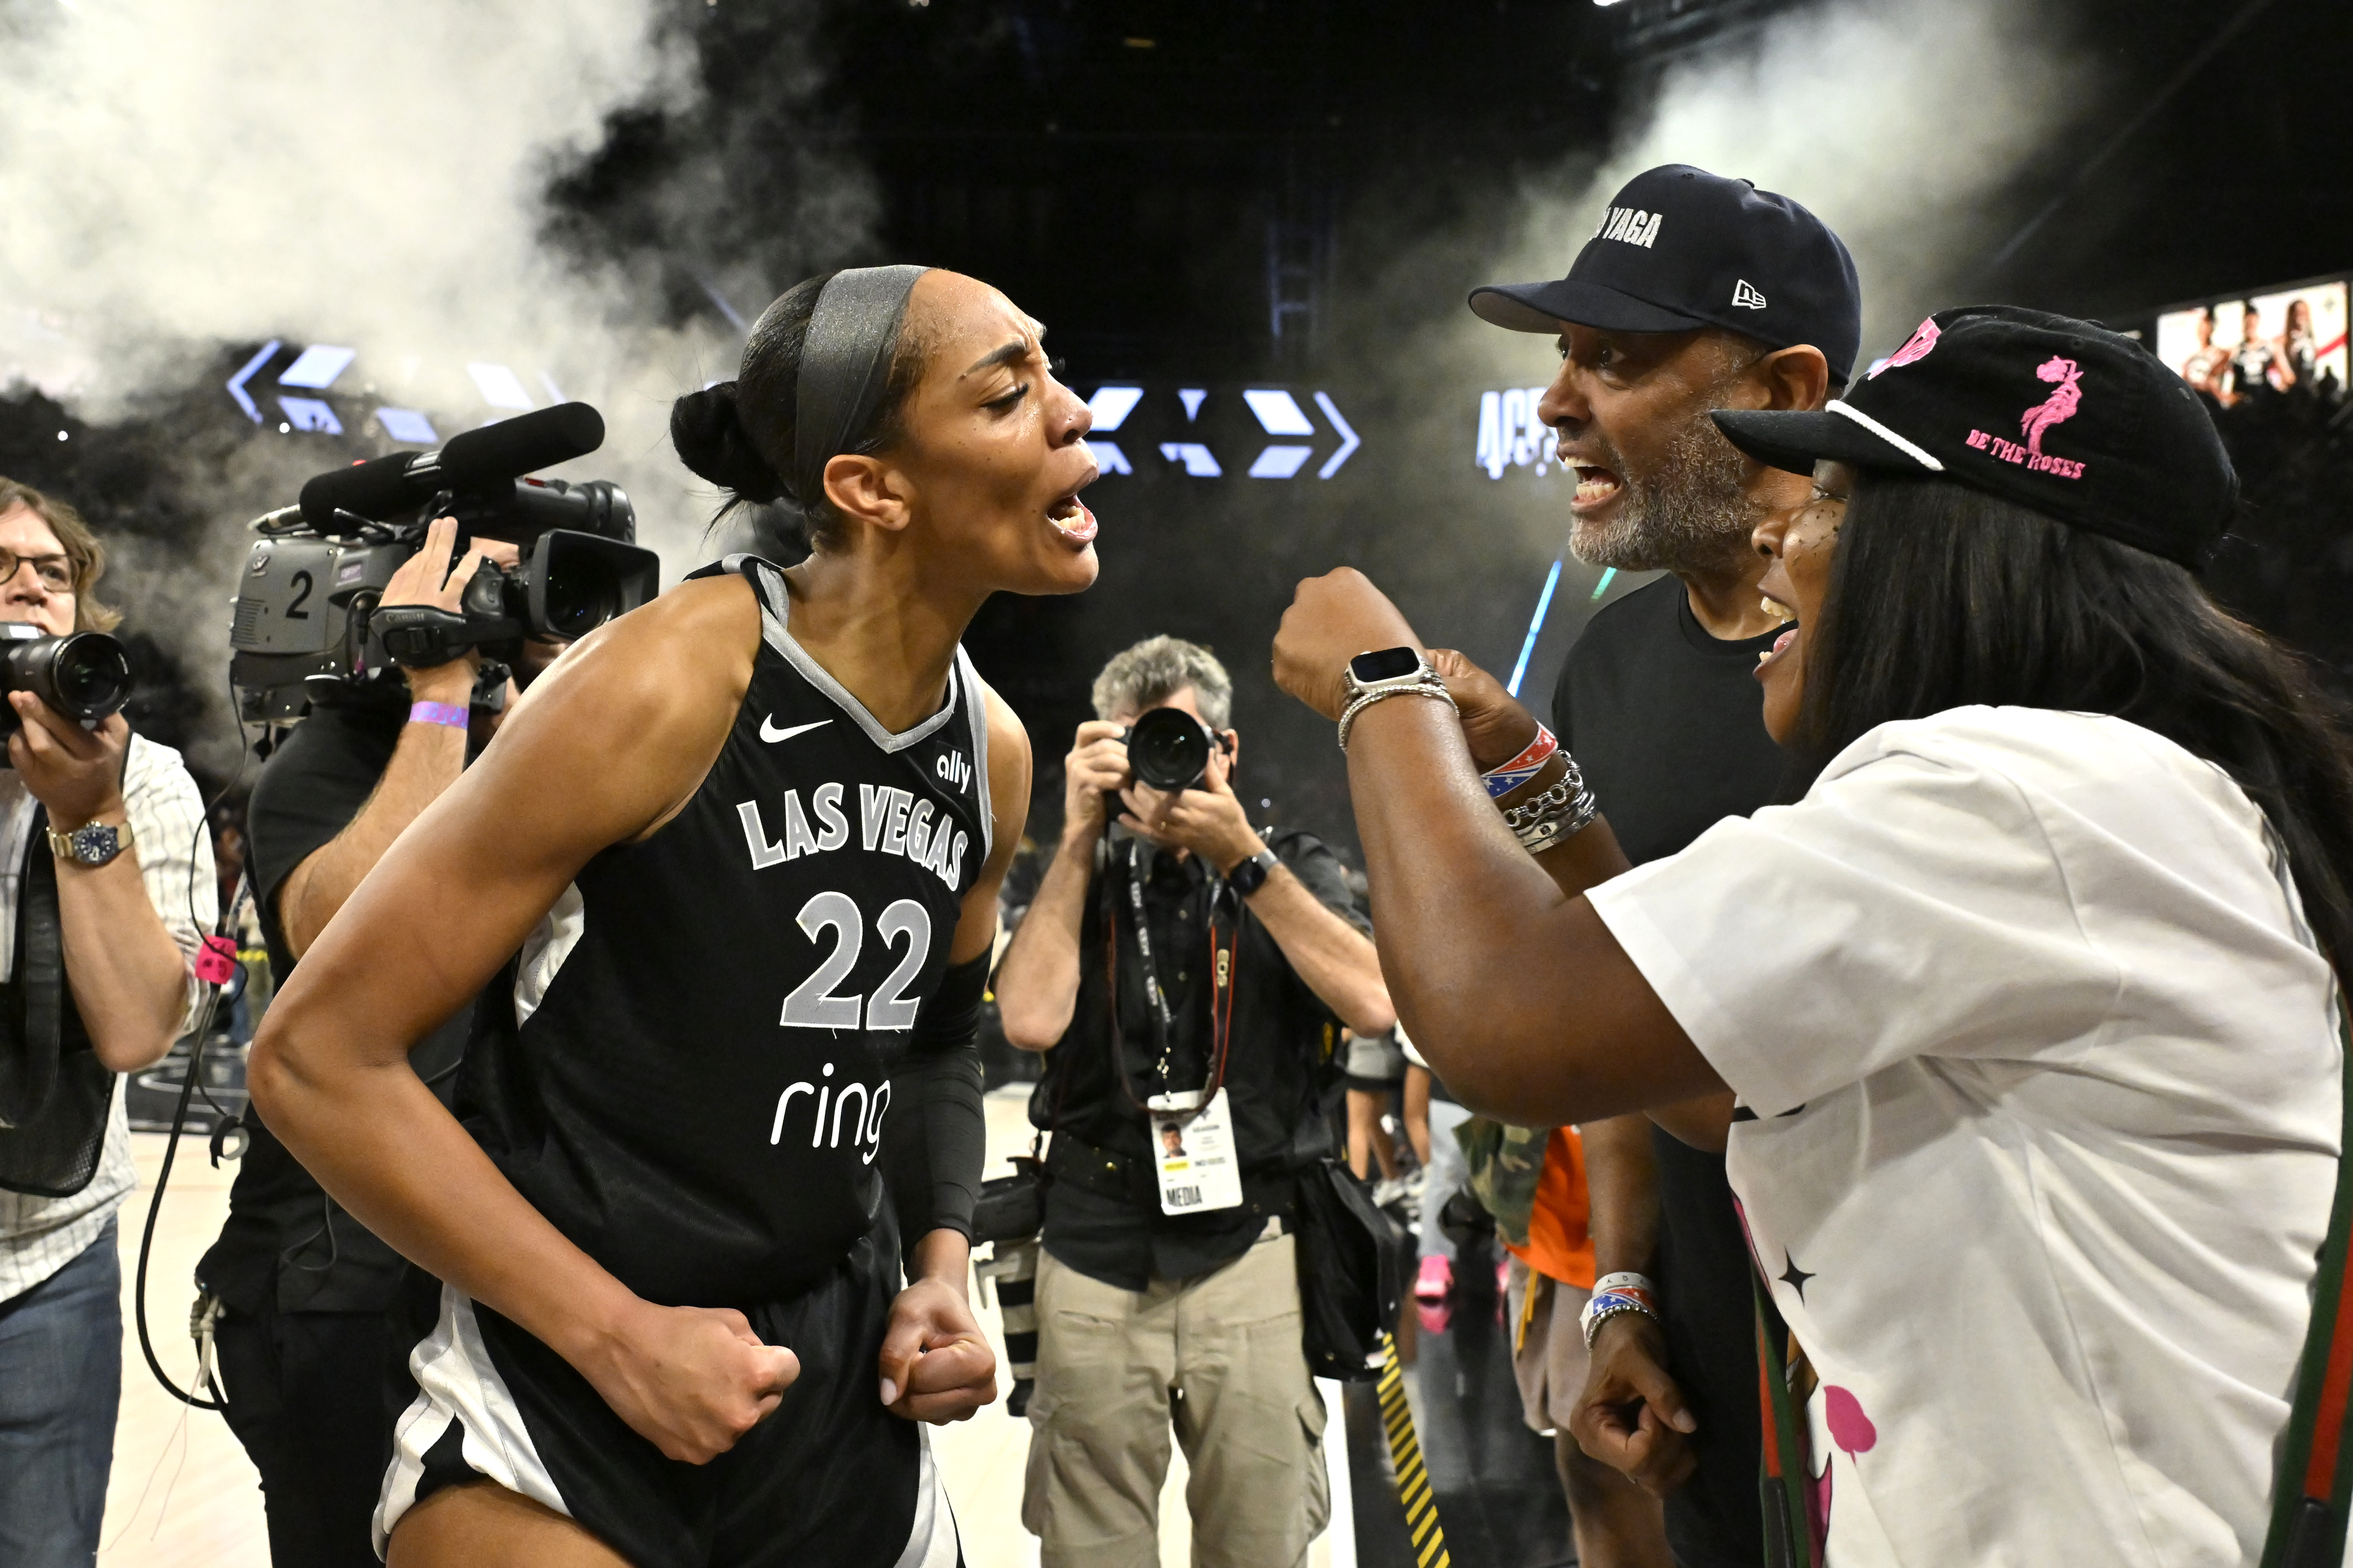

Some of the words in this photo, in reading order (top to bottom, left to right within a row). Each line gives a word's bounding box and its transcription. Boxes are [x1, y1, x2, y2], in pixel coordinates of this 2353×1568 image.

[1602, 207, 1663, 249] YAGA
[1965, 429, 1992, 450] BE
[1990, 437, 2027, 464] THE
[2027, 451, 2086, 480] ROSES
[286, 570, 313, 619] 2
[936, 750, 971, 793] ally
[736, 782, 849, 870] LAS
[859, 783, 968, 891] VEGAS
[779, 891, 932, 1031] 22
[770, 1062, 891, 1165] ring
[1166, 1185, 1203, 1207] MEDIA
